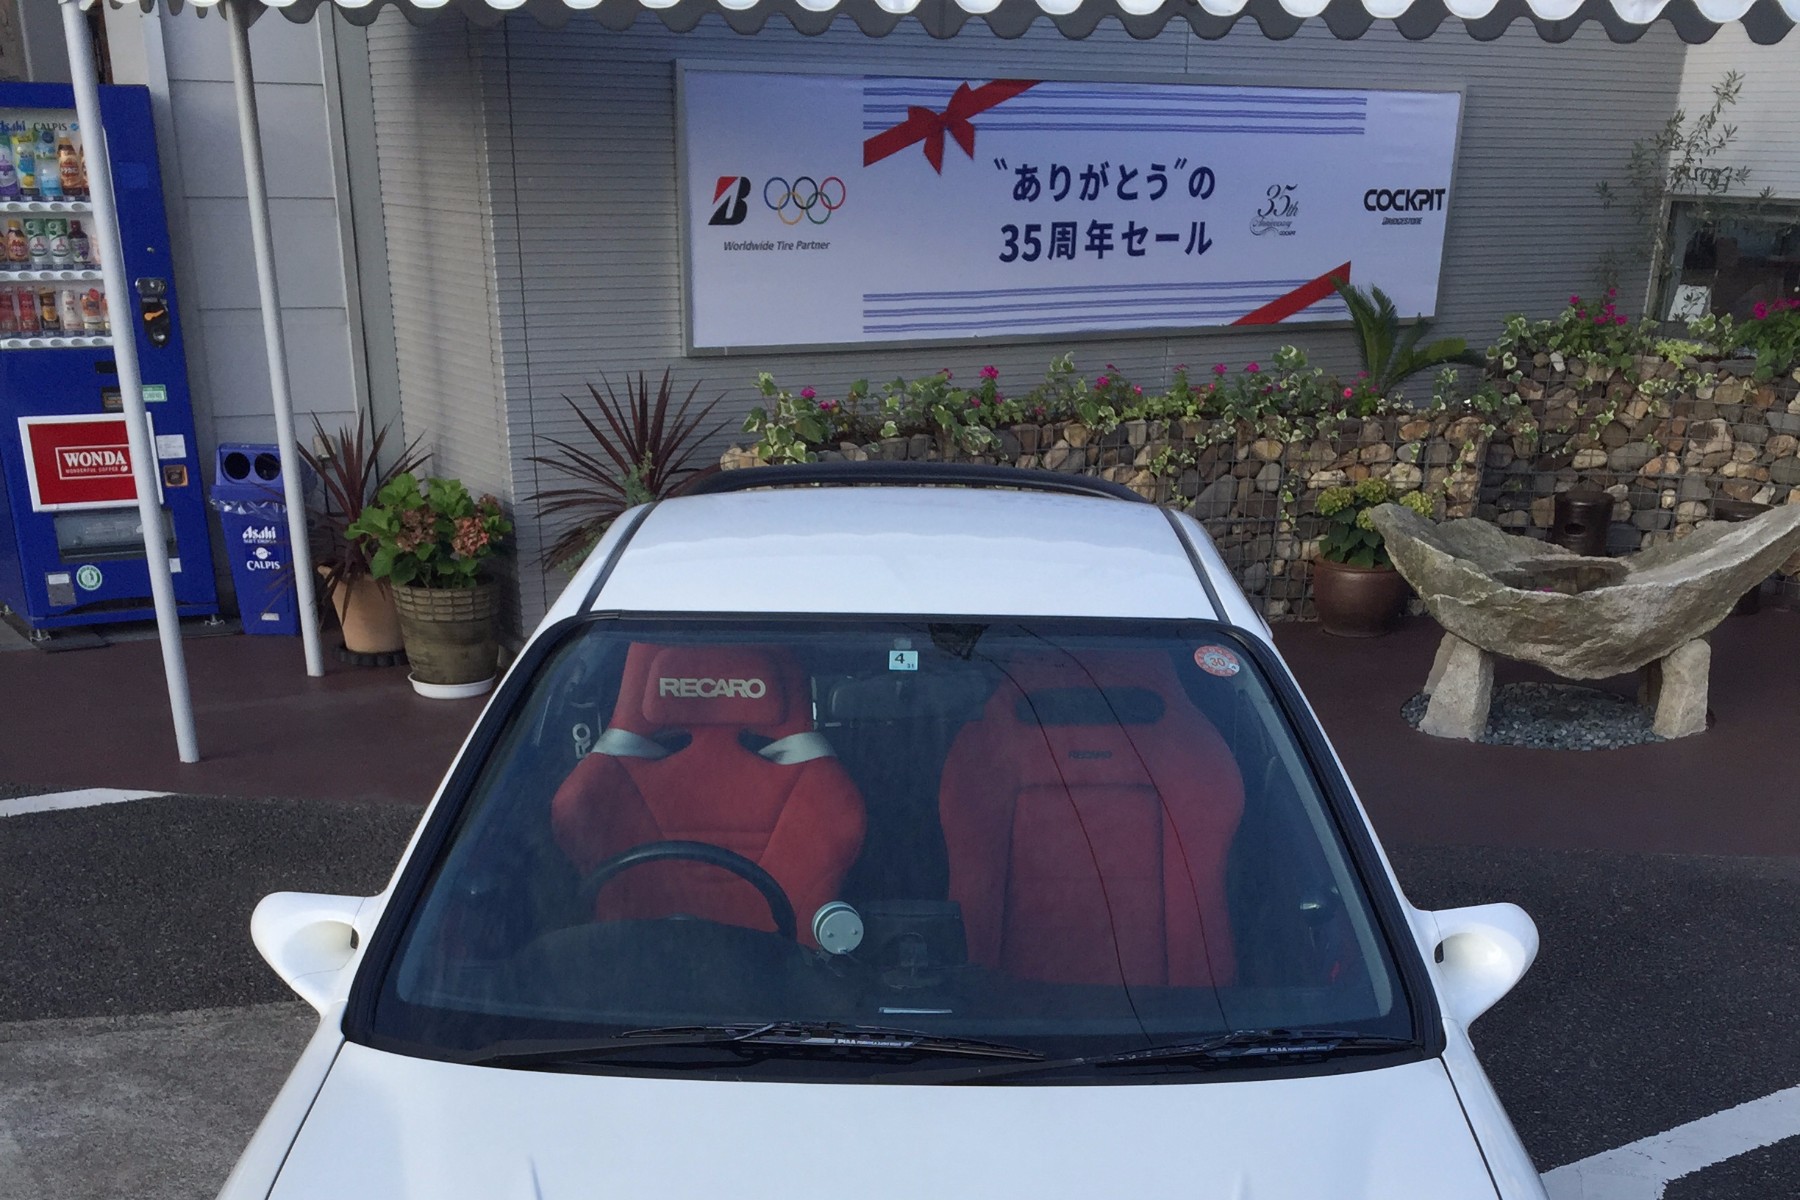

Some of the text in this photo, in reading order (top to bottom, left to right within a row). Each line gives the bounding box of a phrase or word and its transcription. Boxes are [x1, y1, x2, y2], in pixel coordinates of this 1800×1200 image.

[1363, 188, 1446, 211] COCKPIT
[723, 239, 831, 251] Worldwide Tire Partner
[998, 219, 1213, 263] 35周年セール
[63, 450, 127, 467] WONDA
[242, 525, 277, 539] Asahi
[246, 560, 281, 571] CALPIS
[894, 652, 906, 664] 4
[659, 677, 767, 699] RECARO
